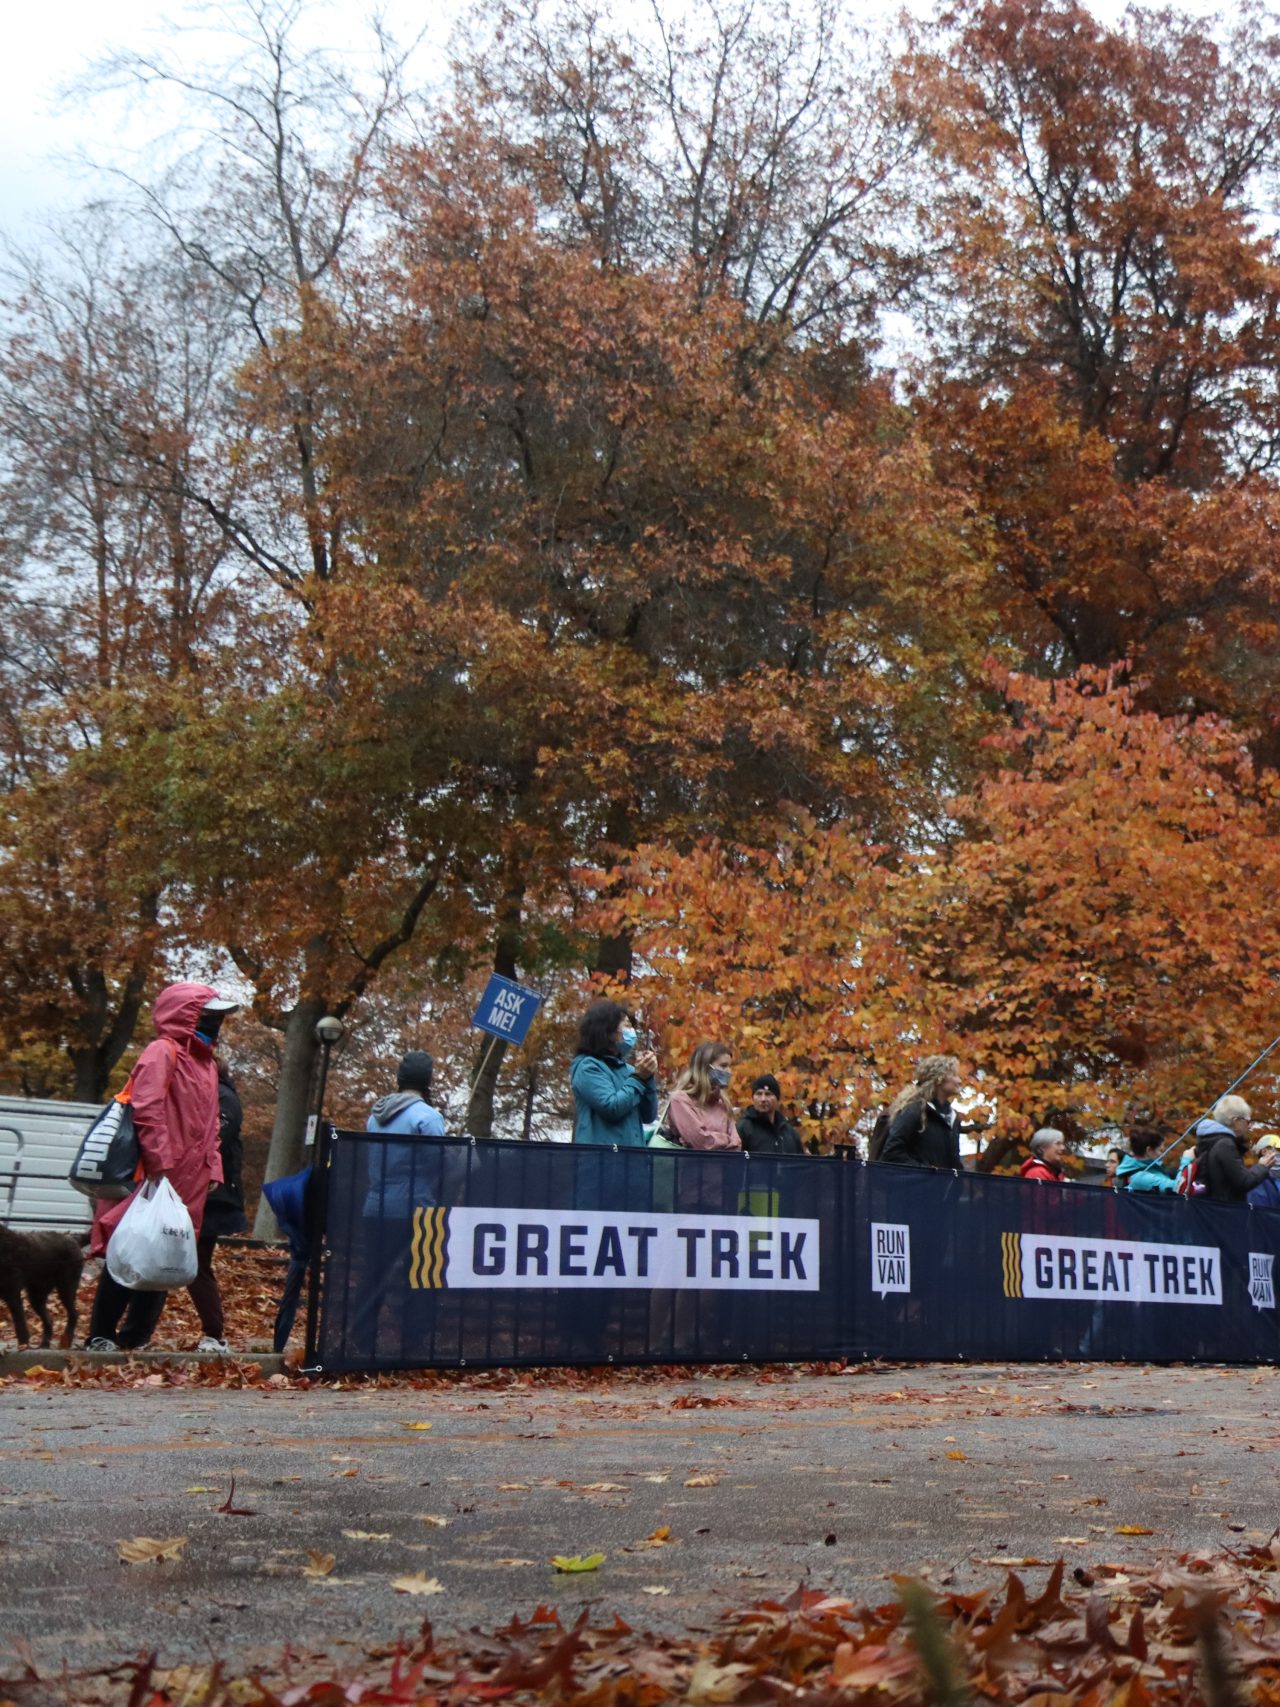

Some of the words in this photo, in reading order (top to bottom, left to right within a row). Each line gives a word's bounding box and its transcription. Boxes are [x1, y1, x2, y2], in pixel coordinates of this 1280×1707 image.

[494, 988, 526, 1015] ASK
[488, 1006, 517, 1033] ME!
[472, 1223, 658, 1276] GREAT
[677, 1228, 807, 1280] TREK
[877, 1229, 905, 1254] RUN
[877, 1259, 905, 1285] VAN
[1035, 1247, 1134, 1292] GREAT
[1144, 1254, 1216, 1296] TREK
[1252, 1258, 1270, 1278] RUN
[1252, 1281, 1272, 1302] VAN
